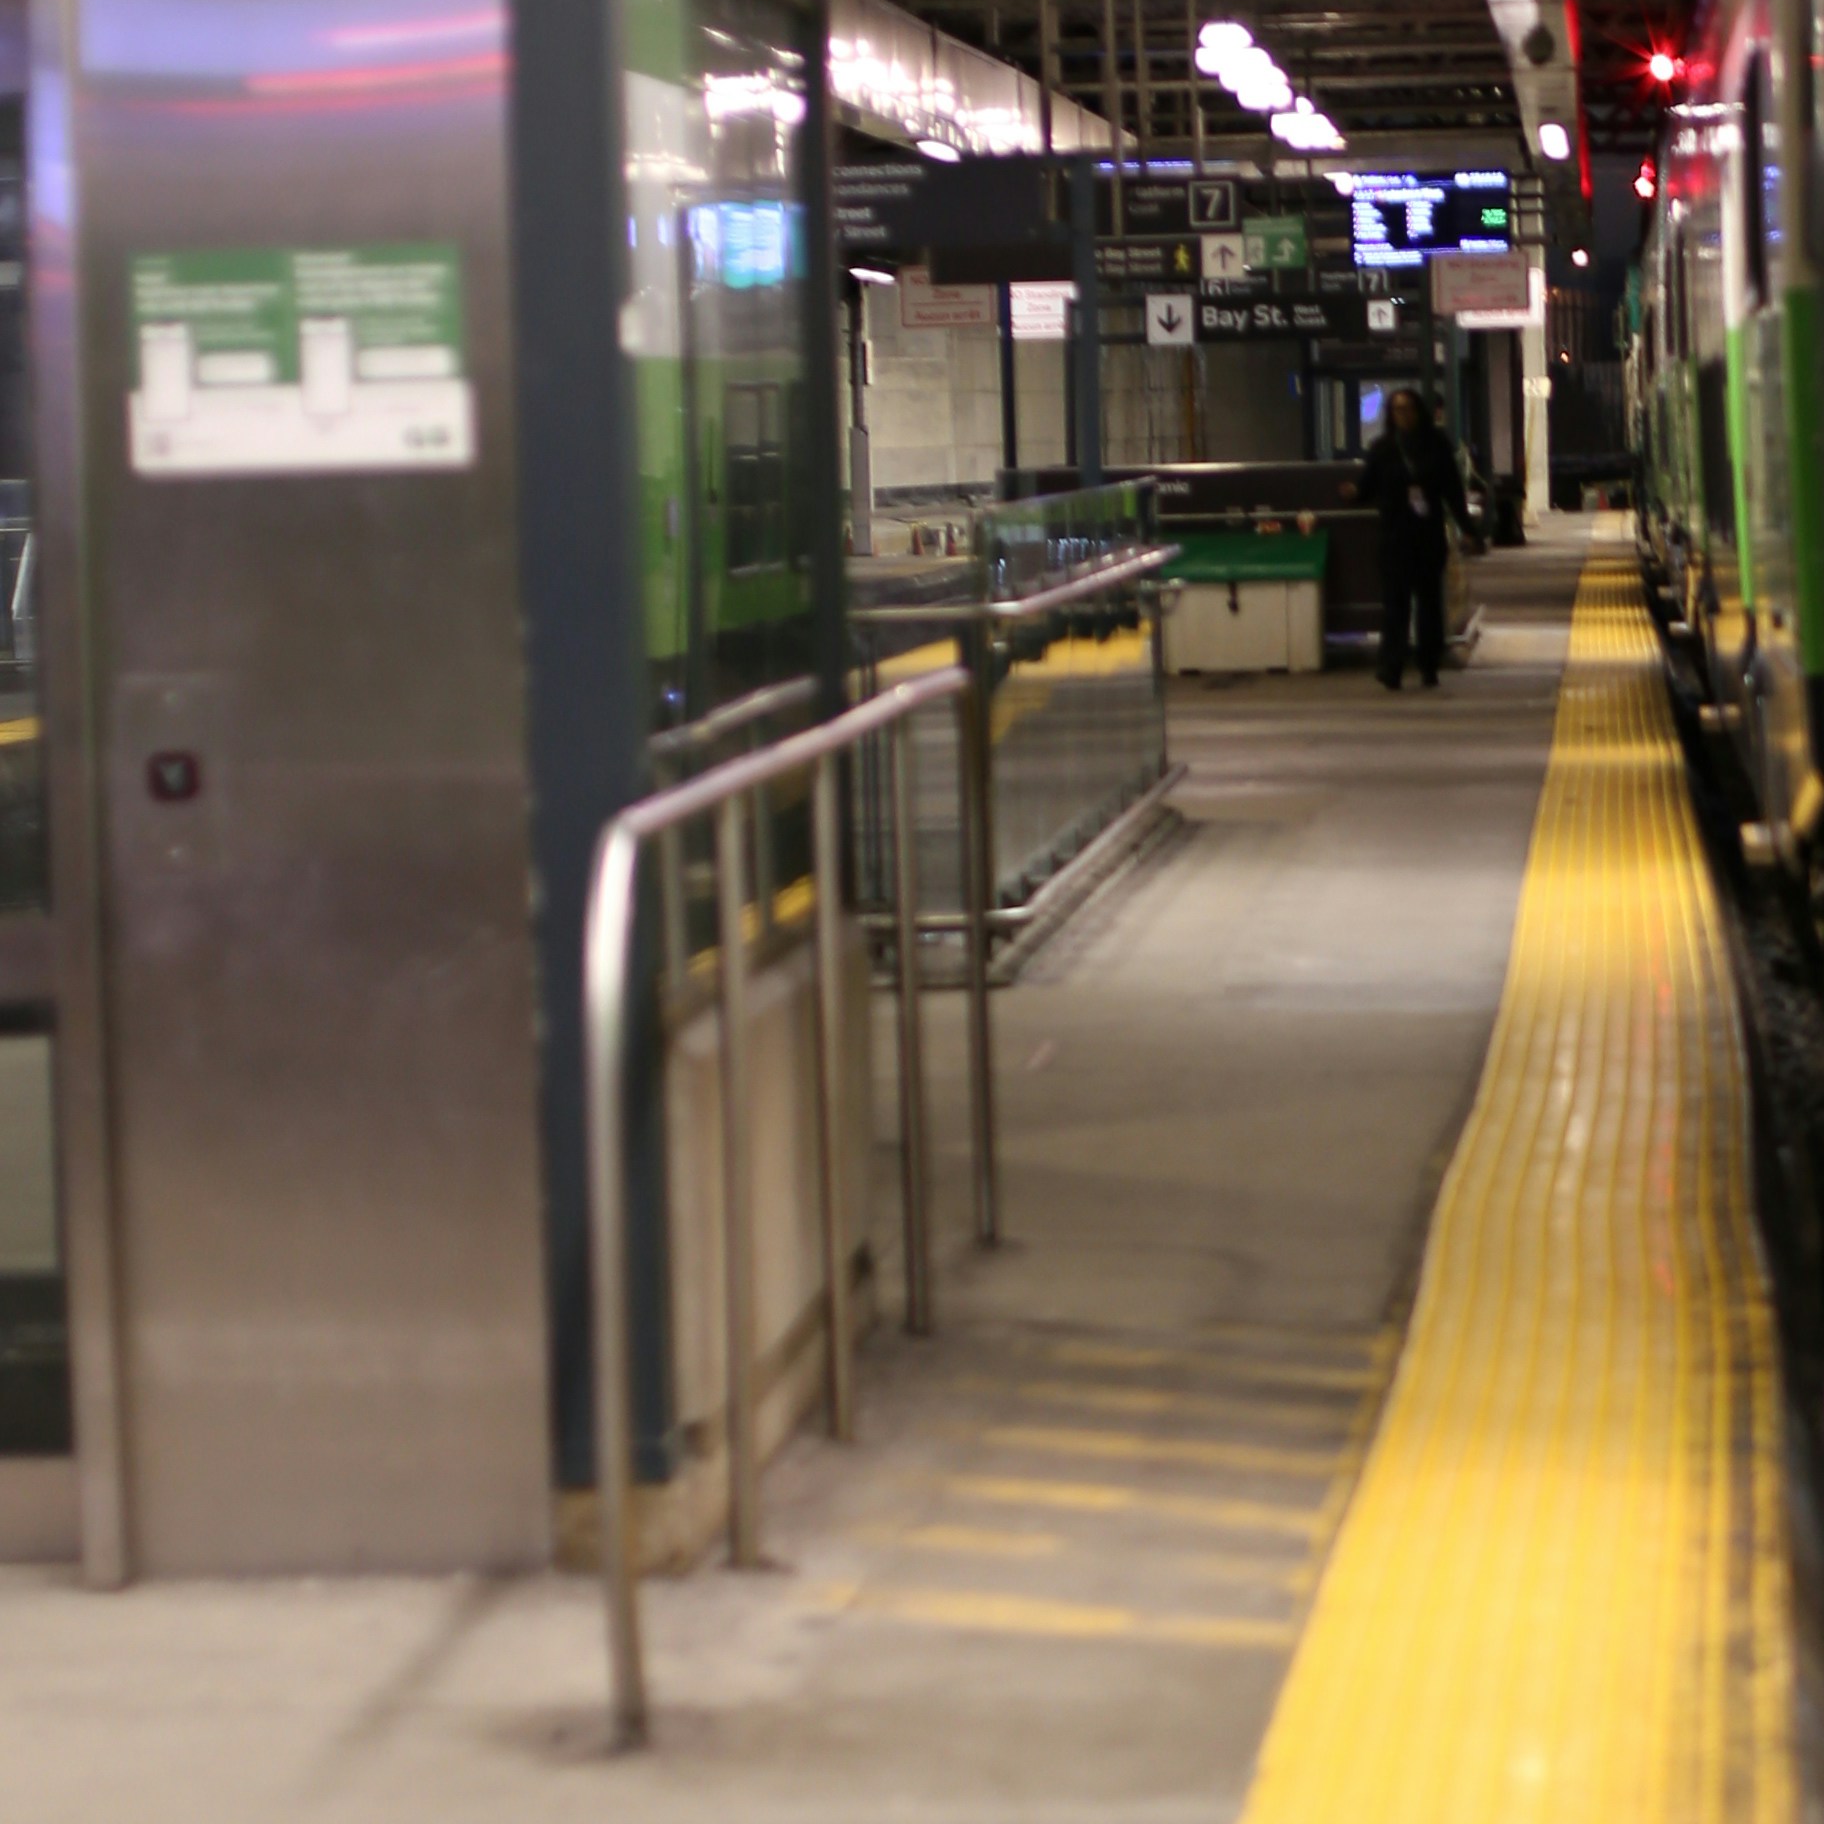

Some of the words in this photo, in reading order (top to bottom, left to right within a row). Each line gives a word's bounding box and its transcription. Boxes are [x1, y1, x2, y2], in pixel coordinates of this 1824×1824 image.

[1199, 188, 1222, 219] 7
[1201, 306, 1248, 332] Bay
[1253, 304, 1289, 327] St.
